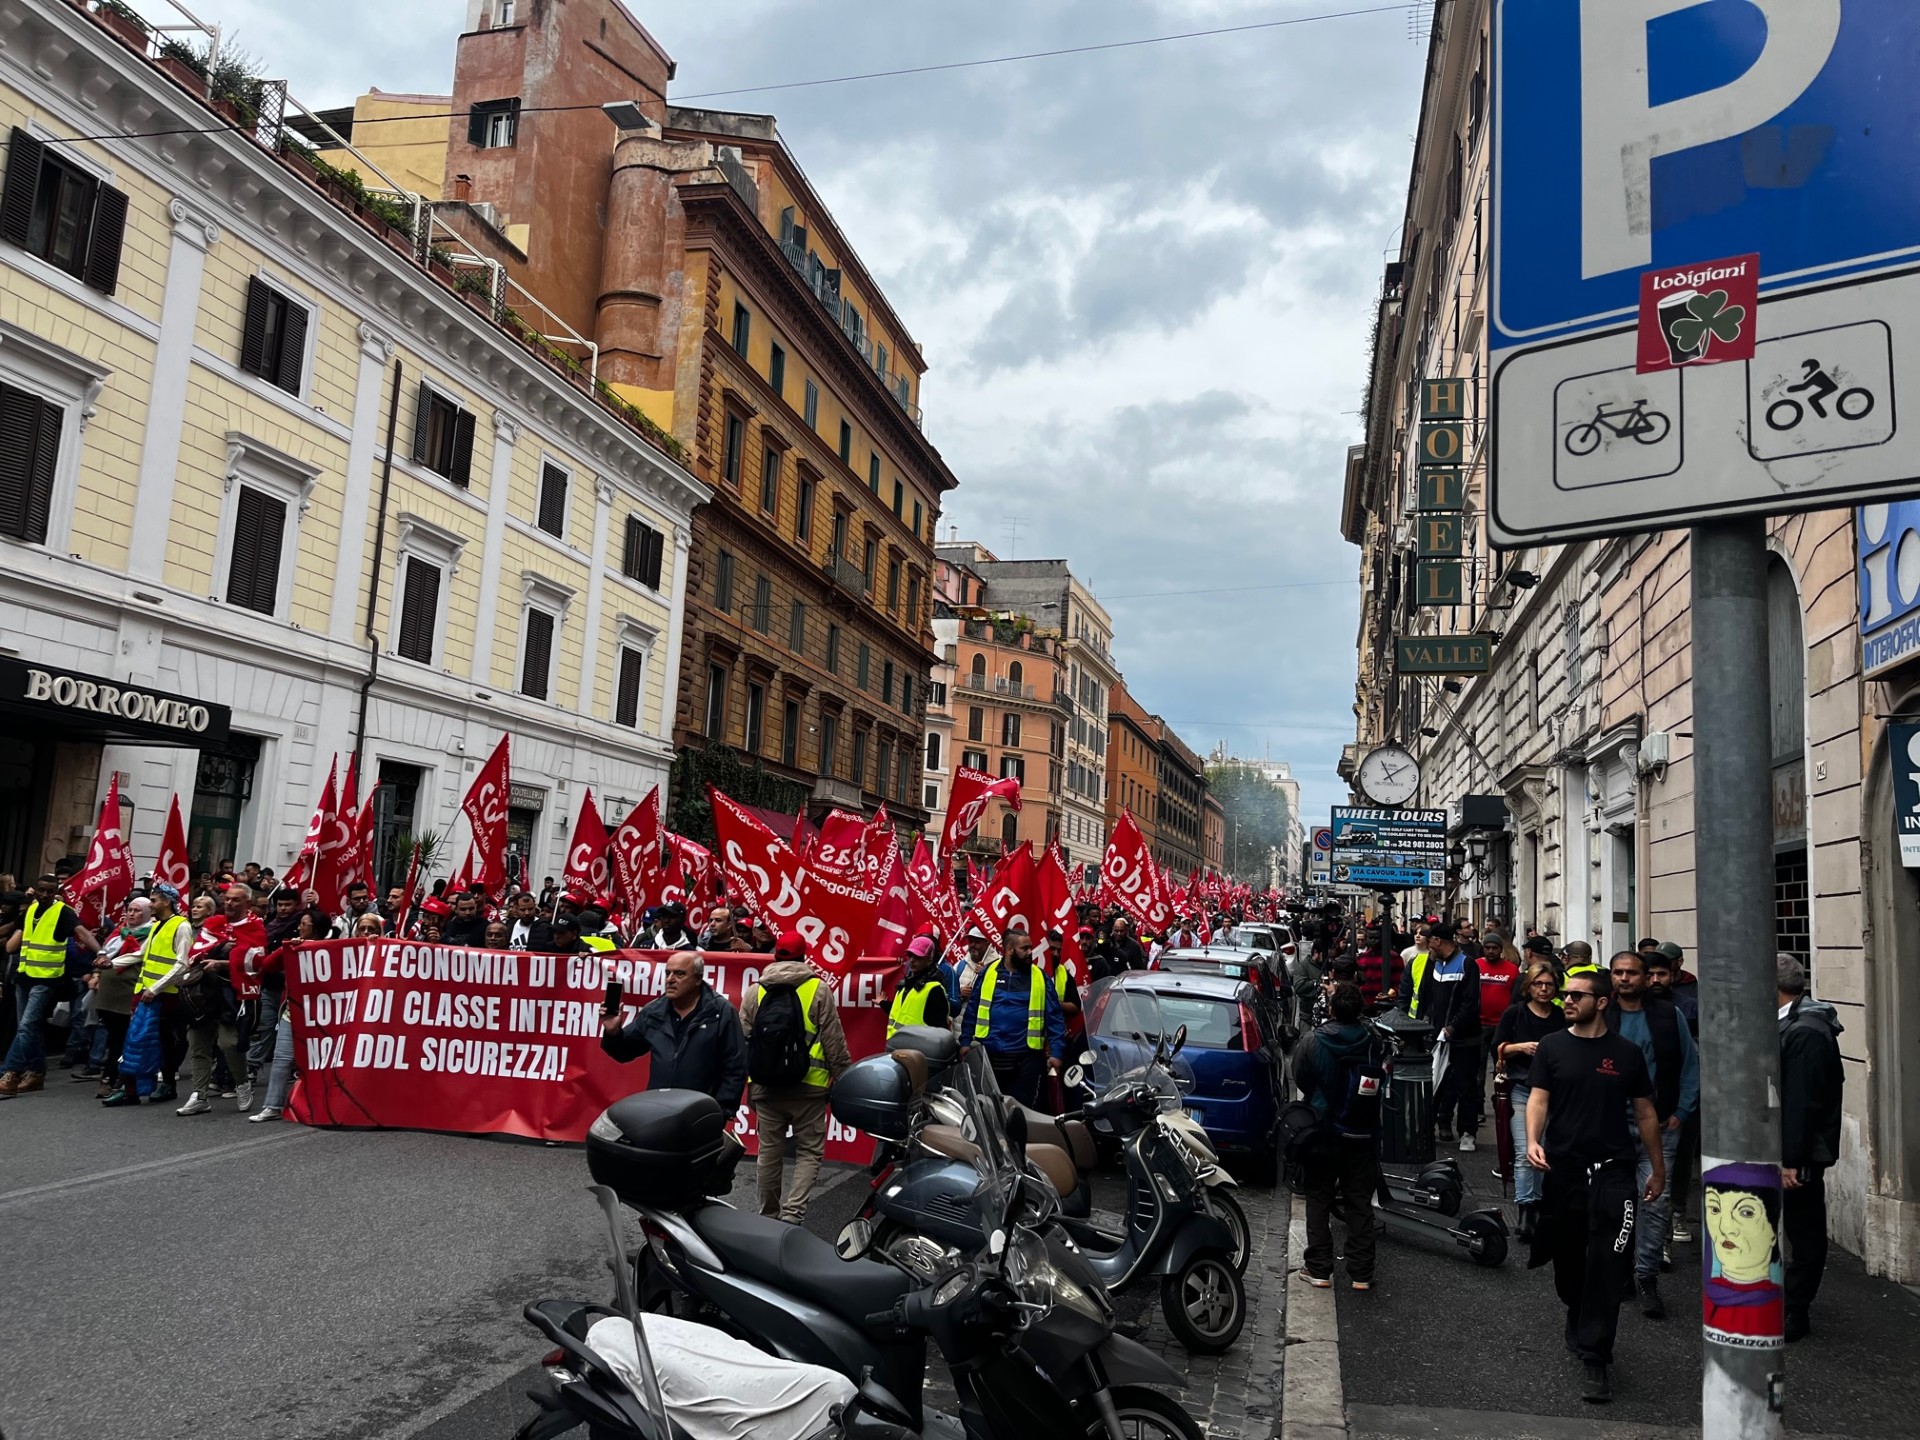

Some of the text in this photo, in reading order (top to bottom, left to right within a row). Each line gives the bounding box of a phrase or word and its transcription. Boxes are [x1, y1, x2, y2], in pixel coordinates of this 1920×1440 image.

[1581, 0, 1841, 281] P
[1426, 383, 1459, 599] HOTEL
[1404, 646, 1484, 665] VALLE
[24, 669, 209, 732] BORROMEO
[511, 786, 544, 799] COLTELLERIA
[1362, 771, 1368, 779] 9
[1335, 808, 1445, 822] WHEEL.TOURS
[1426, 841, 1444, 849] 2803
[298, 948, 332, 983] NO
[528, 956, 556, 987] DI
[363, 989, 395, 1024] DI
[403, 990, 501, 1031] CLASSE
[353, 1033, 410, 1070] DDL
[420, 1037, 569, 1082] SICUREZZA!
[1613, 1199, 1634, 1253] Kappa
